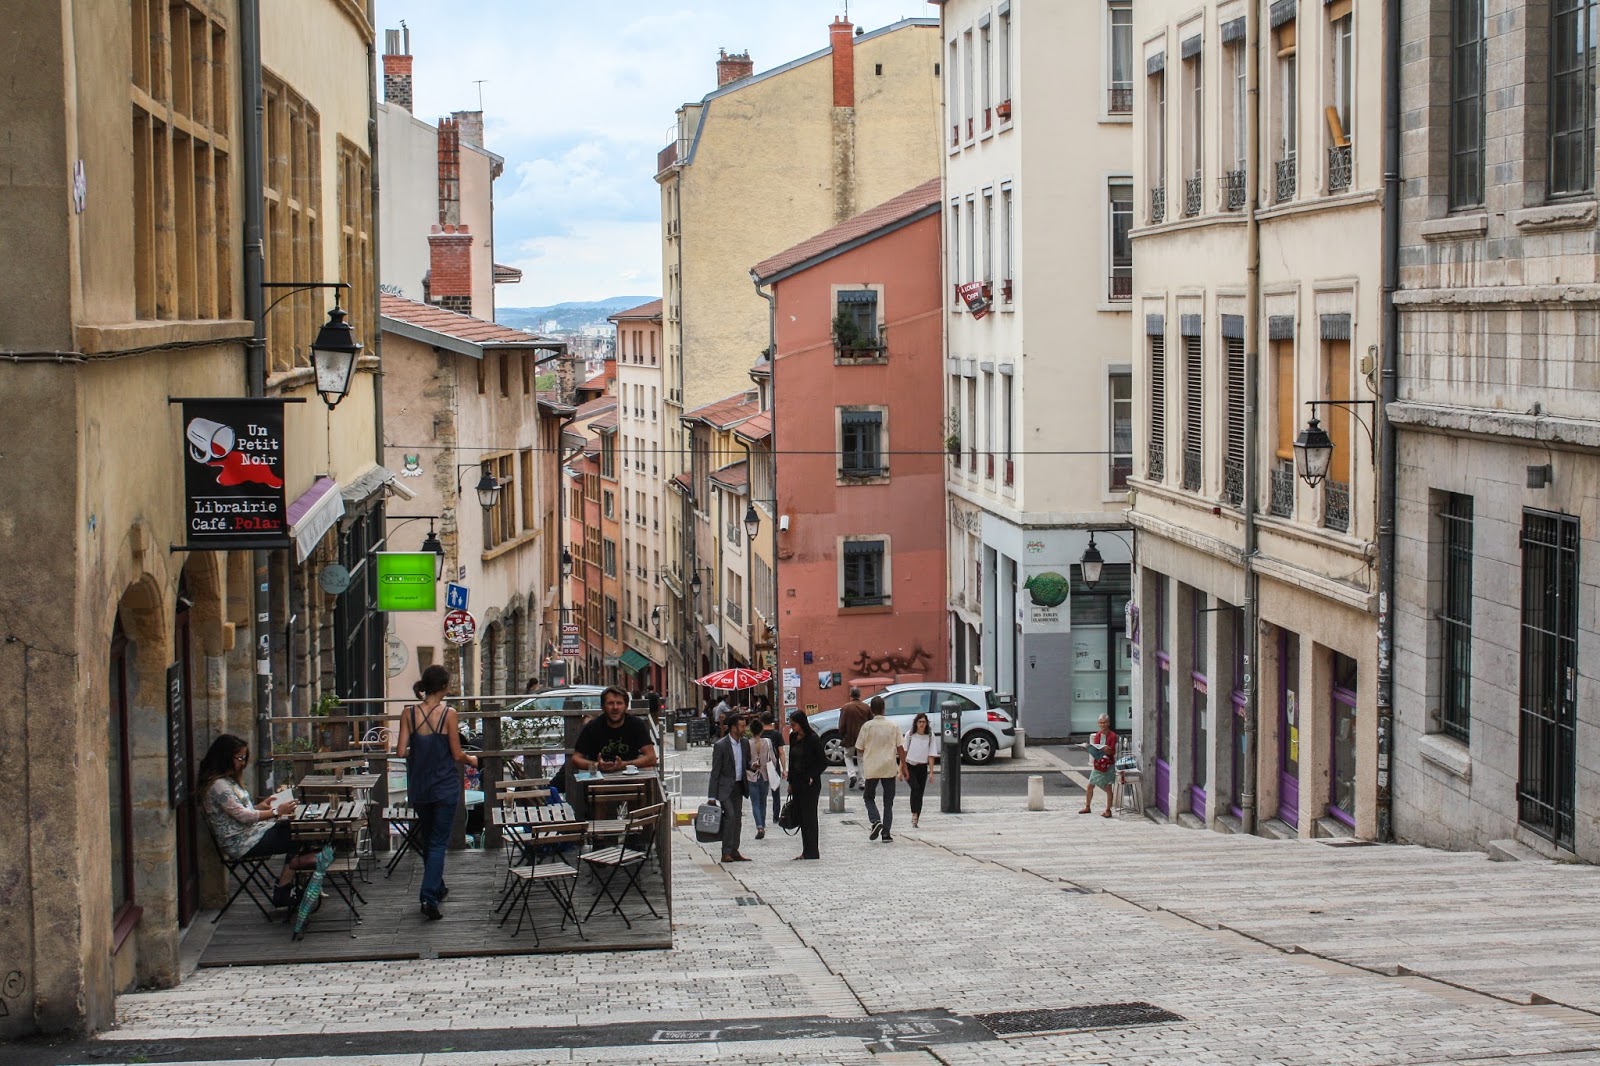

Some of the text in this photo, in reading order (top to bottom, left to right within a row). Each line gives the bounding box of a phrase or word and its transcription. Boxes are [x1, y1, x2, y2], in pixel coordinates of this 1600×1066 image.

[248, 424, 268, 436] Un
[237, 438, 279, 450] Petit
[240, 453, 277, 466] Noir
[195, 500, 277, 513] Librairie
